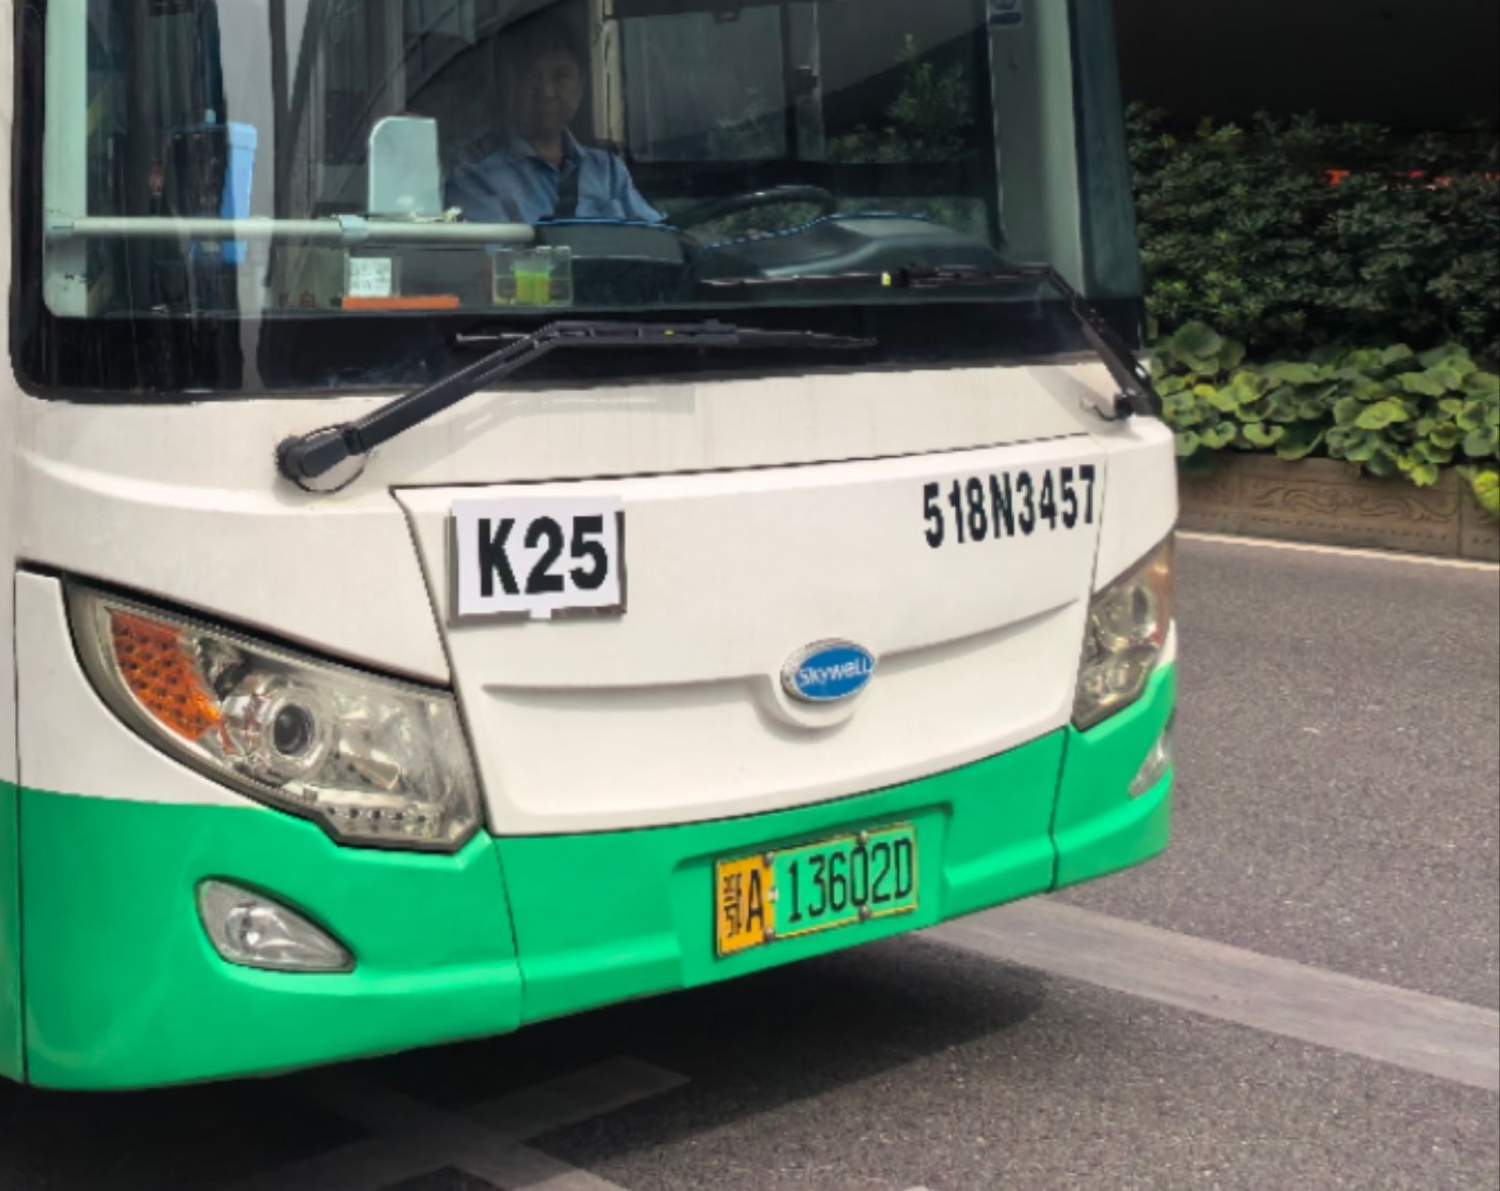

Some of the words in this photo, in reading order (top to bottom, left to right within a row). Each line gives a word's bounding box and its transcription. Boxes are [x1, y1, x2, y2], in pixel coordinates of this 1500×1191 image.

[923, 464, 1095, 549] 518N3457
[477, 515, 608, 598] K25
[787, 837, 913, 923] 13602D
